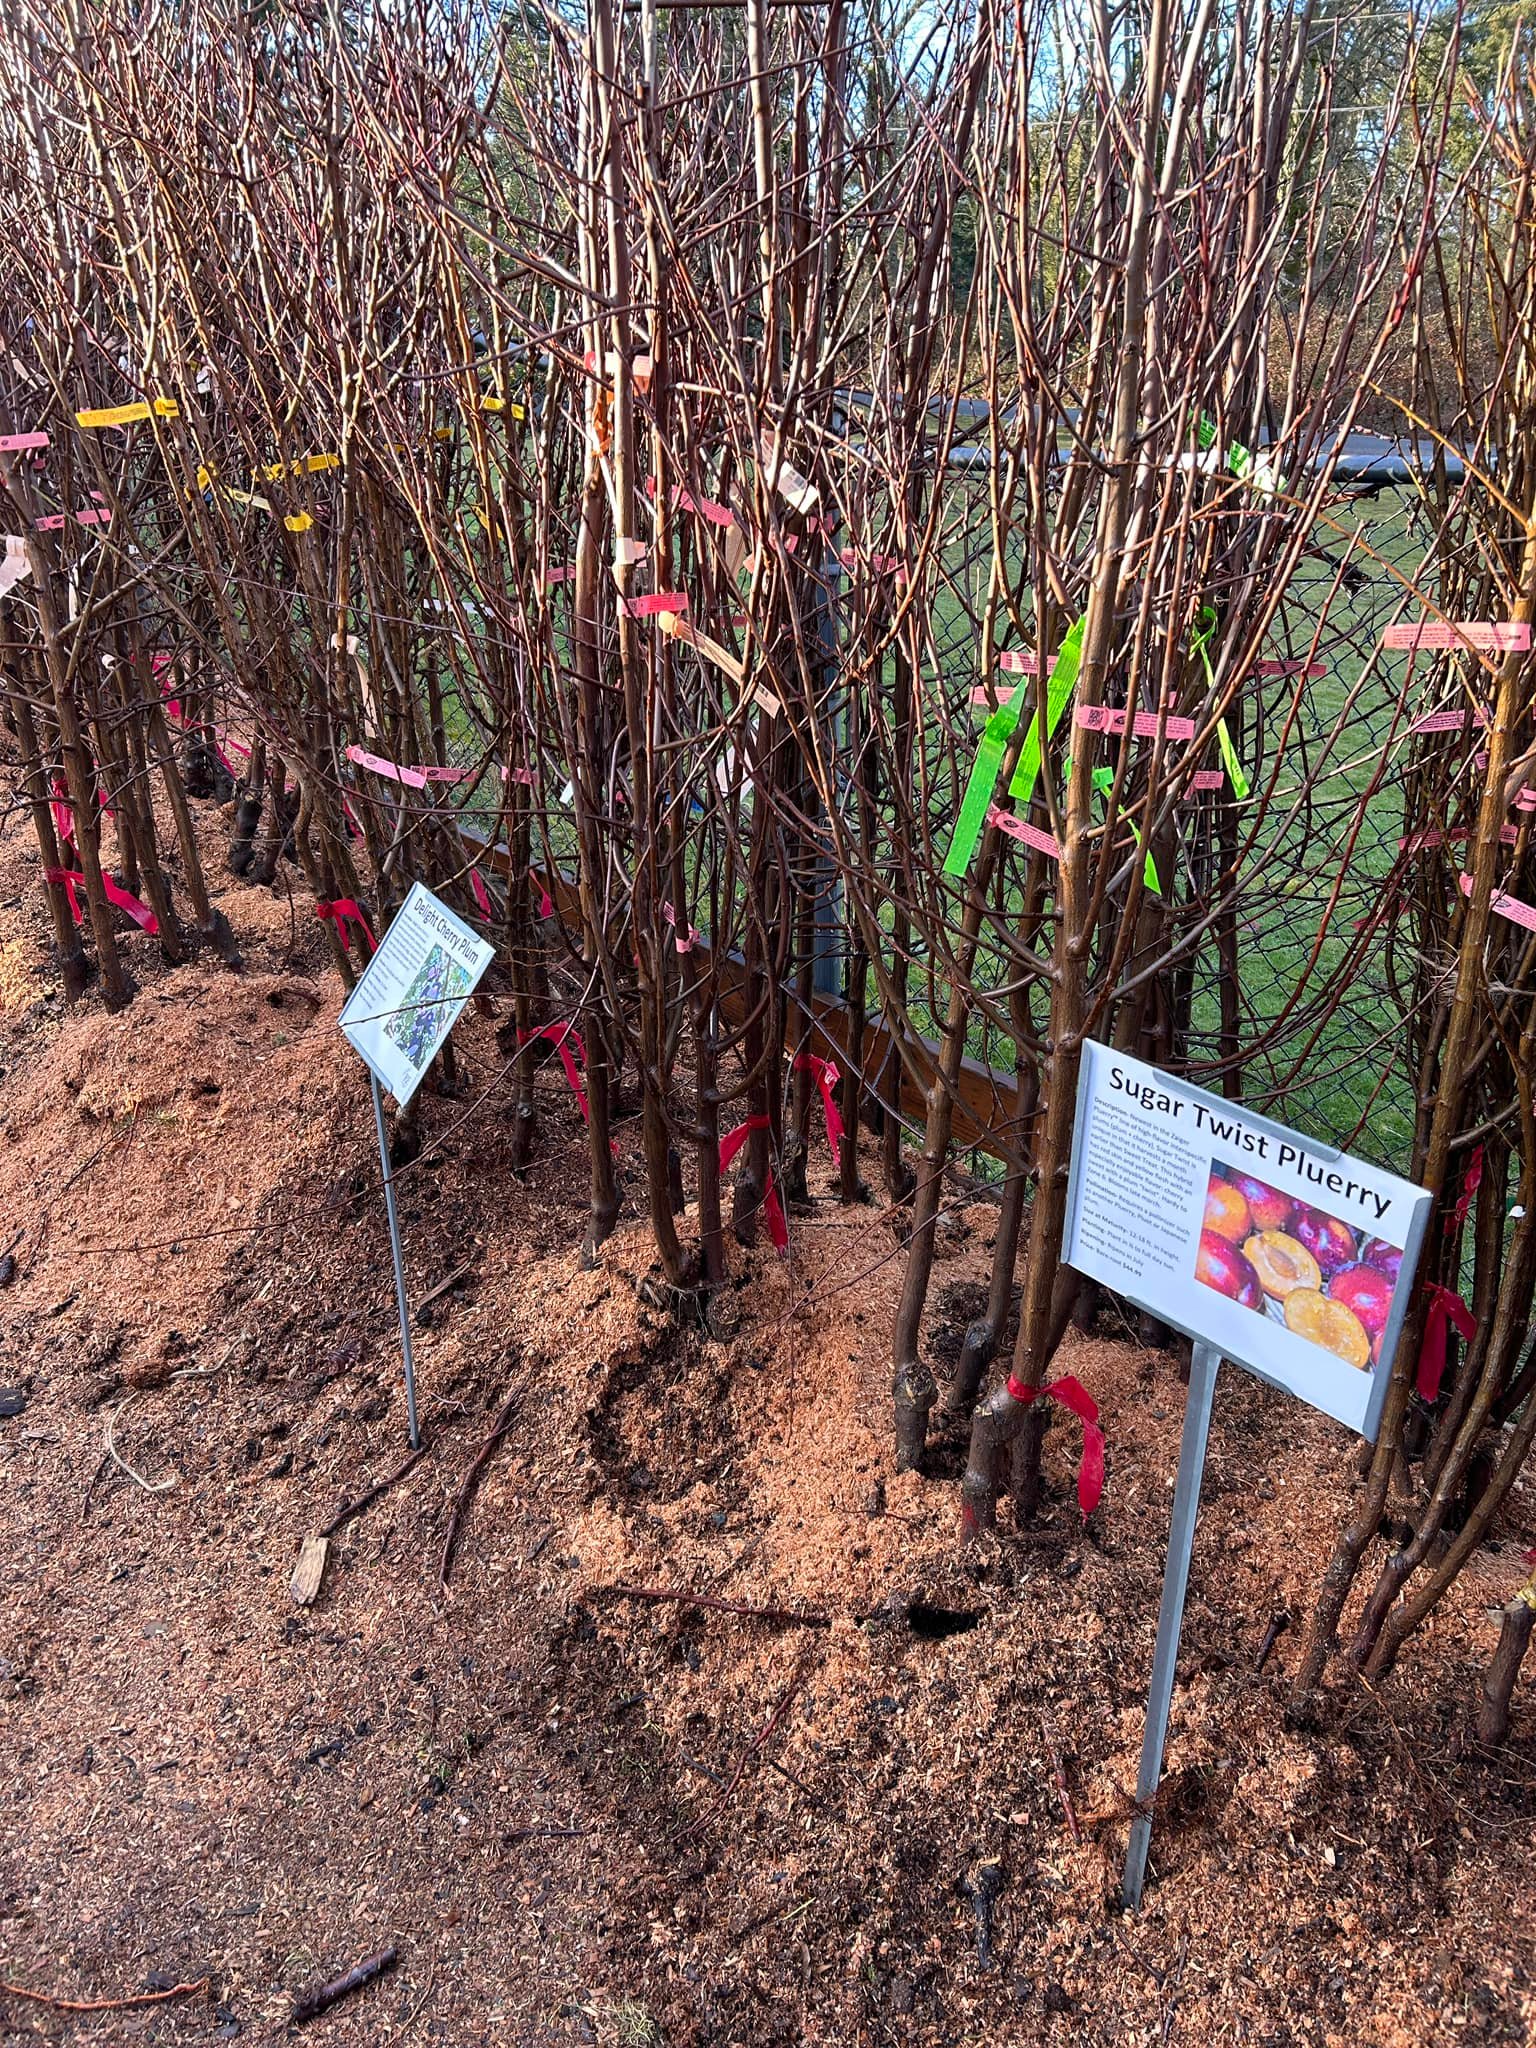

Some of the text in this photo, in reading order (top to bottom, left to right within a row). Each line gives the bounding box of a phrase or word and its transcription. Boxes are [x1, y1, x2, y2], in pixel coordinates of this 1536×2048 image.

[414, 897, 479, 965] Delight Cherry Plum
[1109, 1067, 1393, 1219] Sugar Twist Pluerry
[1159, 1127, 1170, 1136] the
[1088, 1148, 1115, 1167] especially
[1116, 1162, 1143, 1182] enjoyable
[1089, 1140, 1099, 1149] has
[1100, 1145, 1110, 1154] red
[1110, 1150, 1122, 1160] skin
[1123, 1157, 1133, 1166] and
[1135, 1163, 1153, 1178] yellow
[1154, 1172, 1169, 1184] flesh
[1169, 1180, 1183, 1191] with
[1090, 1131, 1108, 1144] earlier
[1109, 1140, 1122, 1151] than
[1123, 1147, 1141, 1161] Sweet
[1160, 1166, 1172, 1176] This
[1173, 1172, 1192, 1187] hybrid
[1118, 1136, 1129, 1146] that
[1136, 1144, 1160, 1161] harvests
[1166, 1159, 1187, 1174] month
[1155, 1144, 1172, 1158] Sugar
[1173, 1153, 1190, 1165] Twist
[1087, 1166, 1100, 1177] Zone
[1129, 1187, 1140, 1198] late
[1088, 1157, 1104, 1170] sweet
[1105, 1166, 1118, 1177] with
[1123, 1175, 1138, 1188] plum
[1161, 1195, 1179, 1209] Hardy
[1083, 1205, 1094, 1215] Size
[1092, 1189, 1113, 1204] another
[1160, 1225, 1187, 1245] Japanese
[1118, 1194, 1143, 1213] Requires
[1176, 1224, 1190, 1236] such
[1107, 1230, 1120, 1242] Plant
[1141, 1249, 1150, 1258] full
[1151, 1254, 1162, 1266] day
[1107, 1242, 1125, 1257] Ripens
[1132, 1256, 1143, 1268] July
